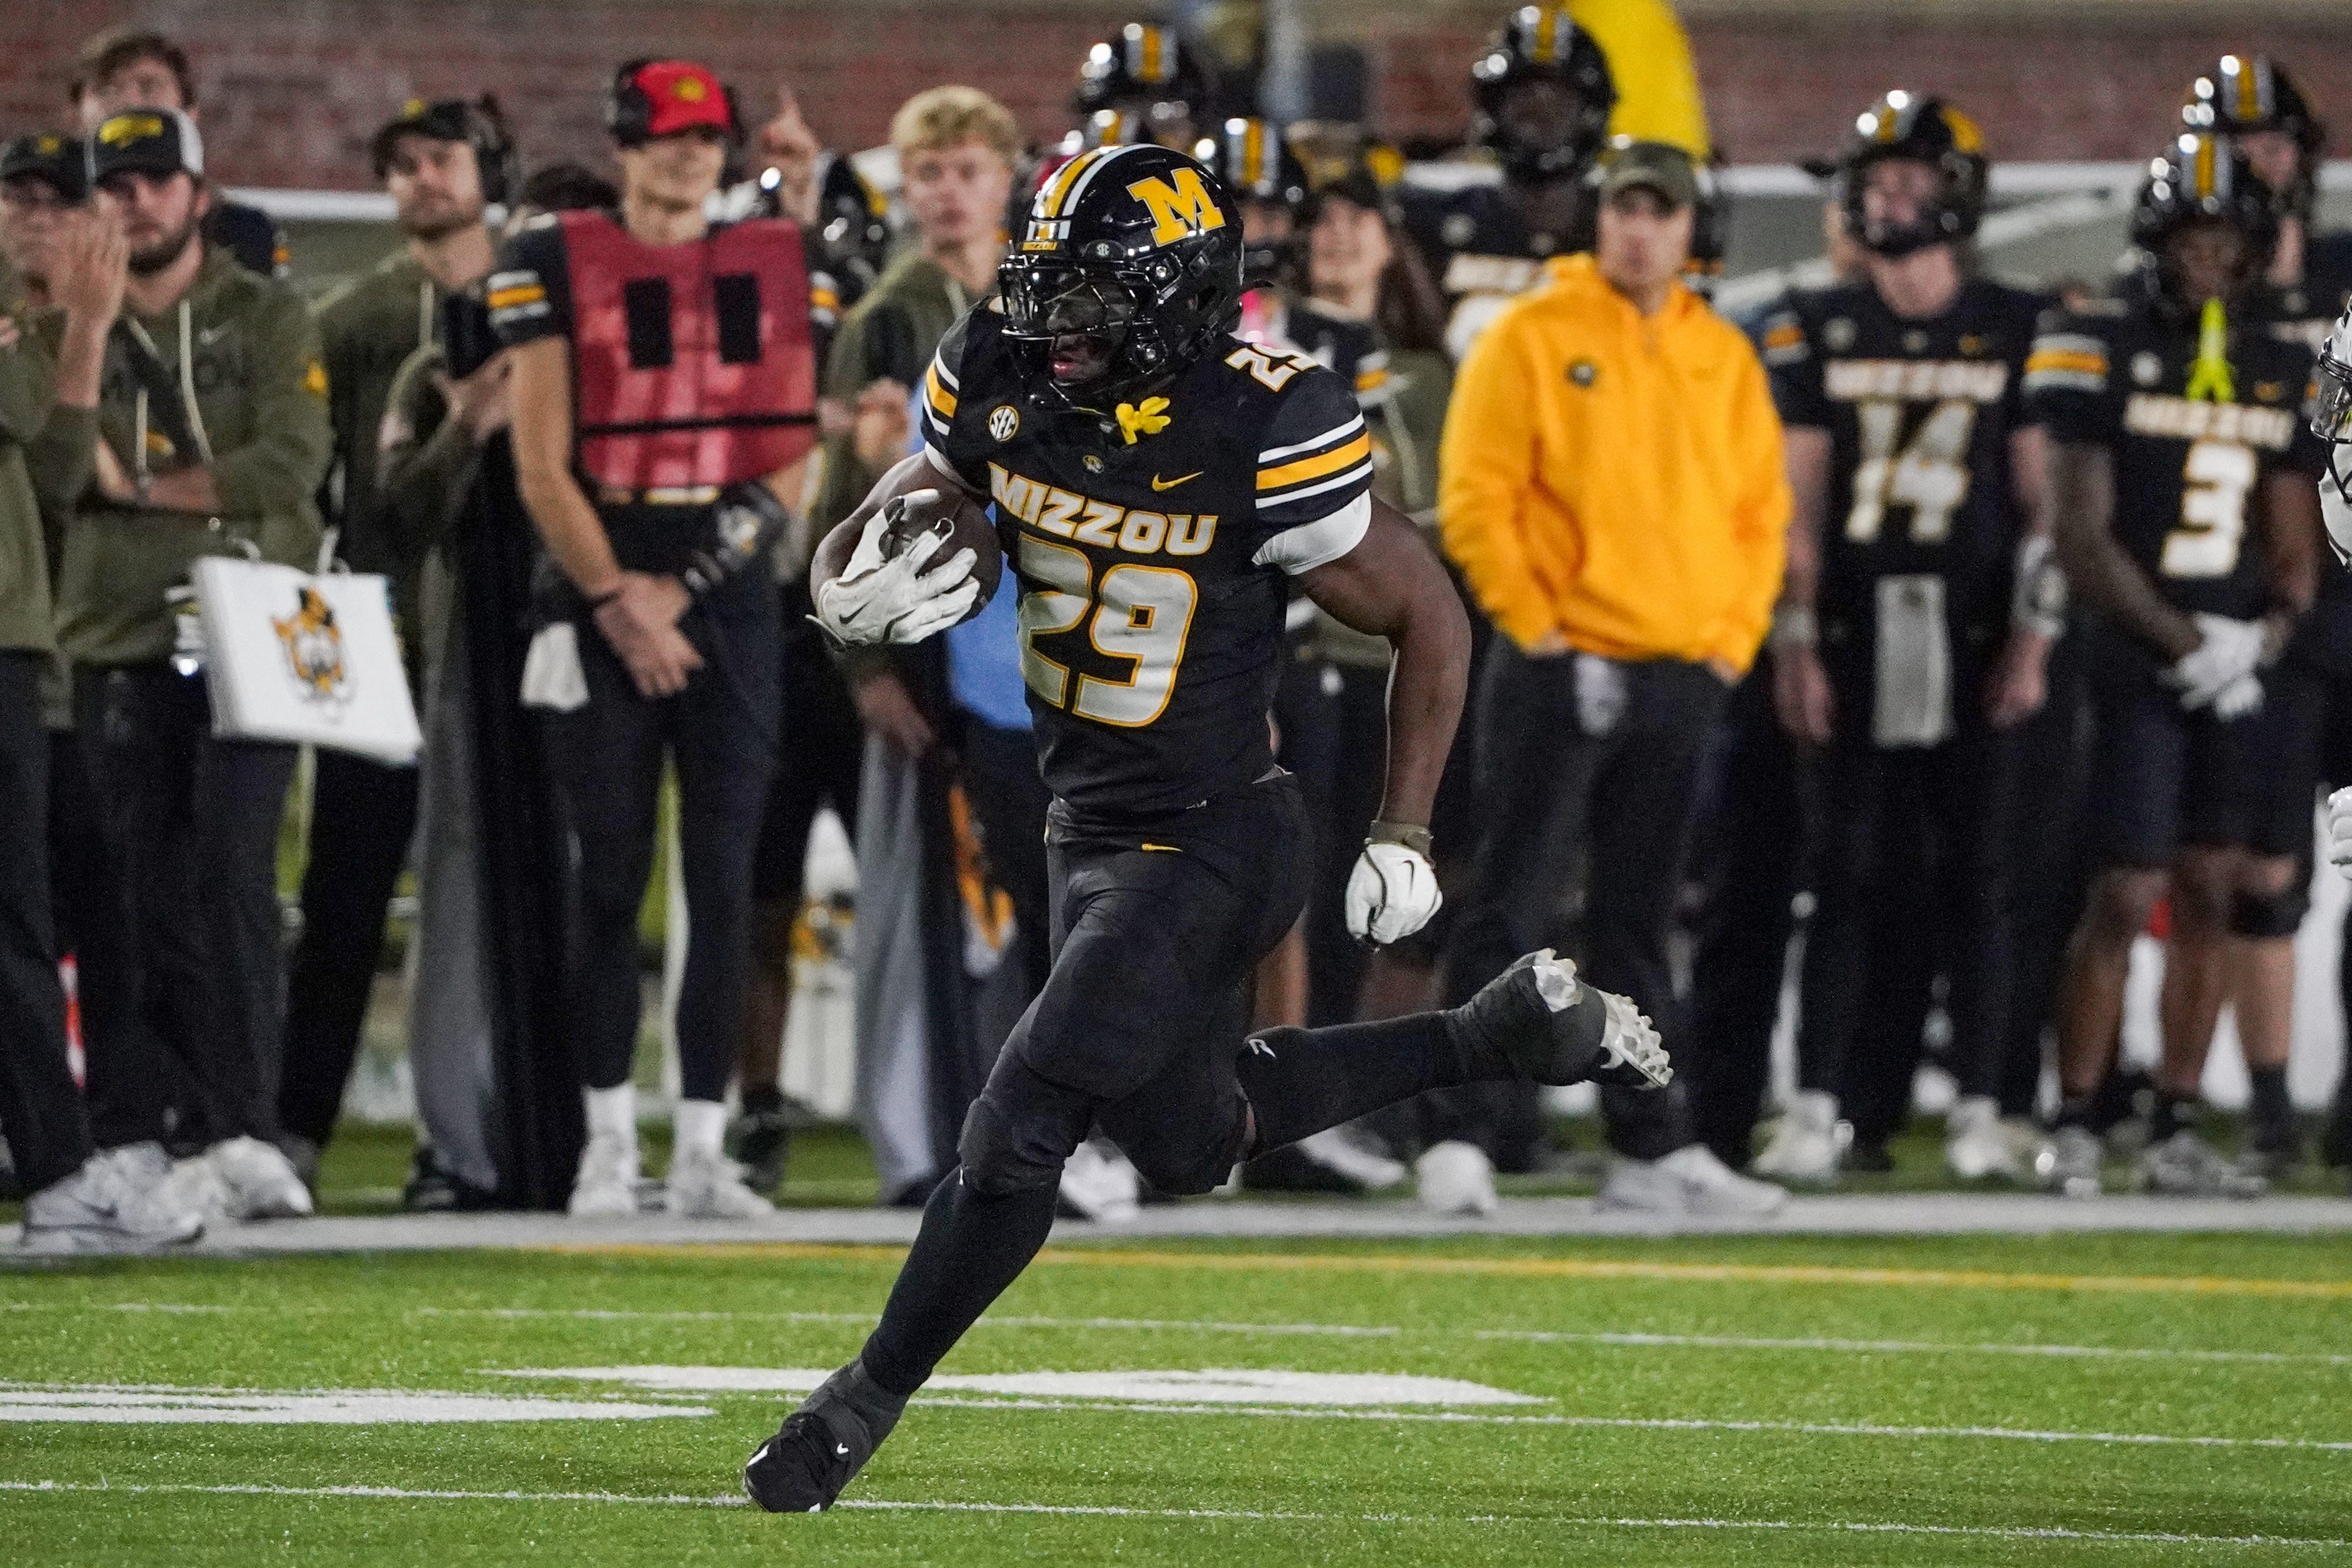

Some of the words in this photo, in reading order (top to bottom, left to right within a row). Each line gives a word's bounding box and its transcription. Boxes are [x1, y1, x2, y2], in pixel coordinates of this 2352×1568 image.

[1126, 167, 1226, 247] M
[990, 408, 1016, 440] SEC
[1845, 401, 1974, 542] 14
[987, 460, 1218, 556] MIZZOU
[2162, 441, 2257, 577] 3
[1017, 530, 1198, 727] 29
